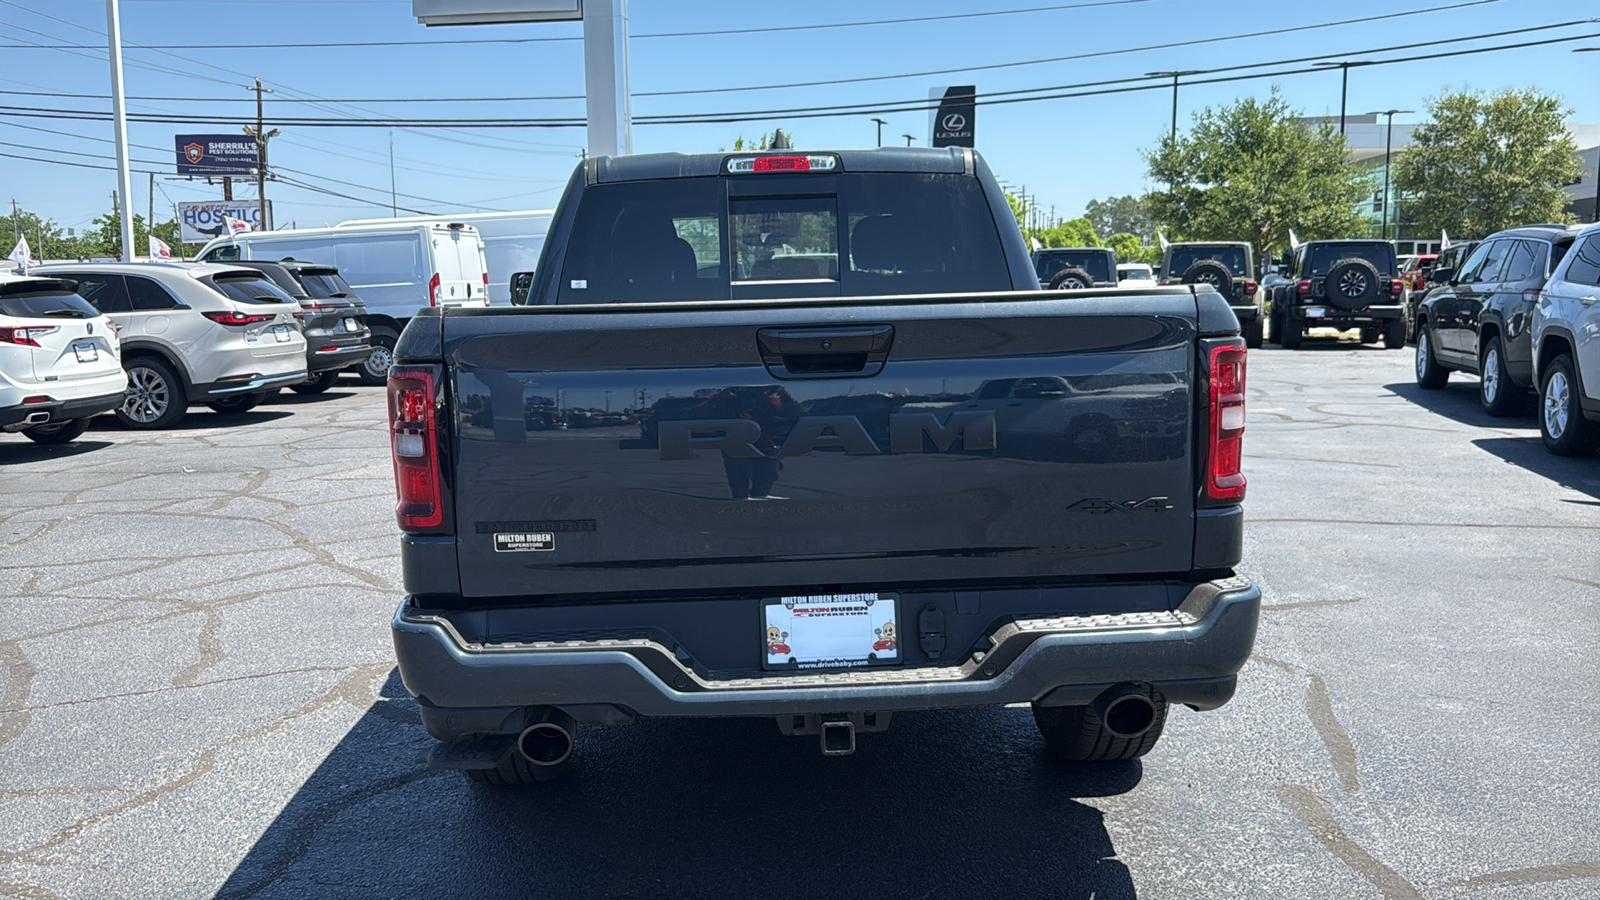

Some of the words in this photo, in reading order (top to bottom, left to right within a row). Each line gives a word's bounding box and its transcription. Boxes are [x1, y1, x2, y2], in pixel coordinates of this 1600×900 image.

[208, 142, 257, 150] SHERRILL'S
[658, 409, 998, 461] RAM
[497, 534, 525, 543] MILTON
[526, 533, 551, 542] RUBEN
[808, 595, 832, 603] RUBEN
[833, 593, 878, 602] SUPERSTORE
[798, 660, 868, 669] www.drivebaby.com
